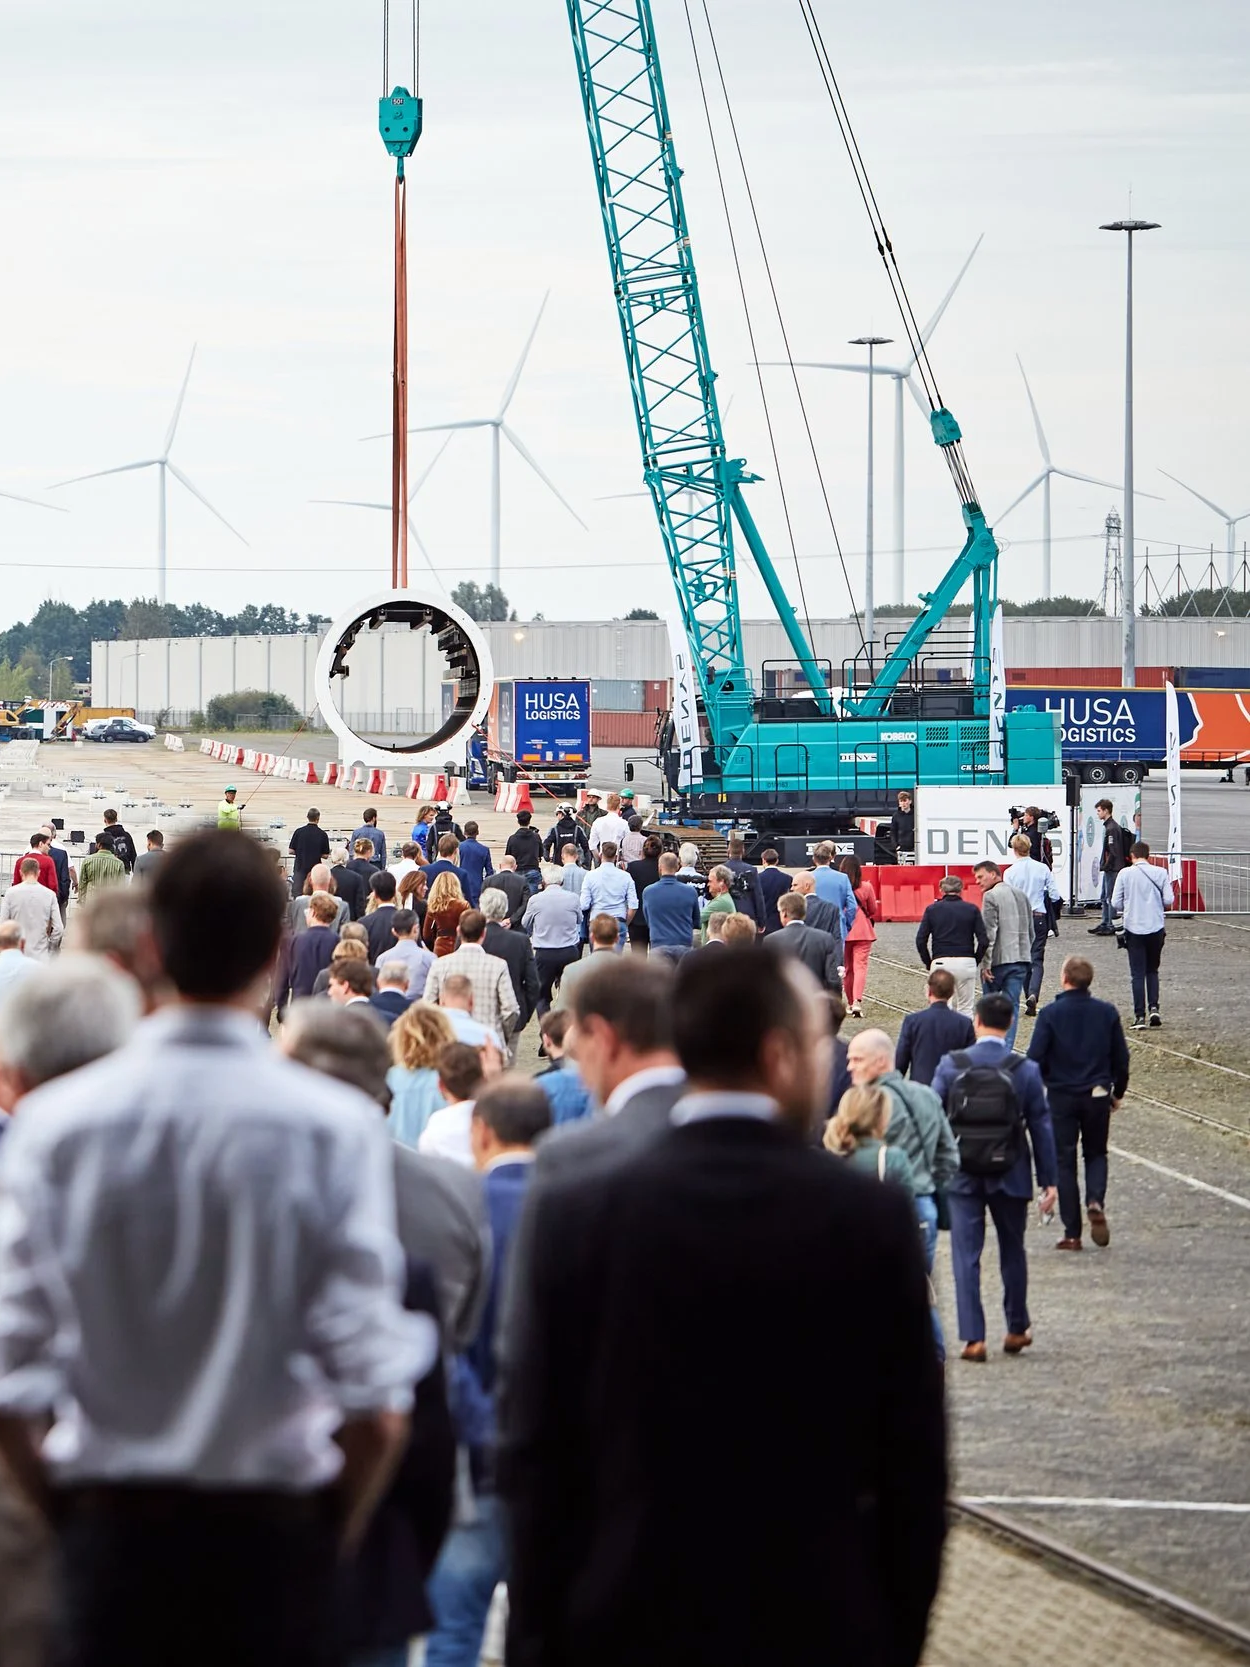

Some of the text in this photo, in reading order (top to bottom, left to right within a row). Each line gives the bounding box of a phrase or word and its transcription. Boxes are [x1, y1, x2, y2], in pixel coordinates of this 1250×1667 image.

[525, 692, 579, 710] HUSA
[525, 710, 581, 720] LOGISTICS
[1045, 697, 1135, 726] HUSA
[880, 732, 917, 741] KOBELCO
[1061, 727, 1136, 743] GISTICS
[806, 844, 854, 854] DYS
[927, 828, 1062, 856] DENS
